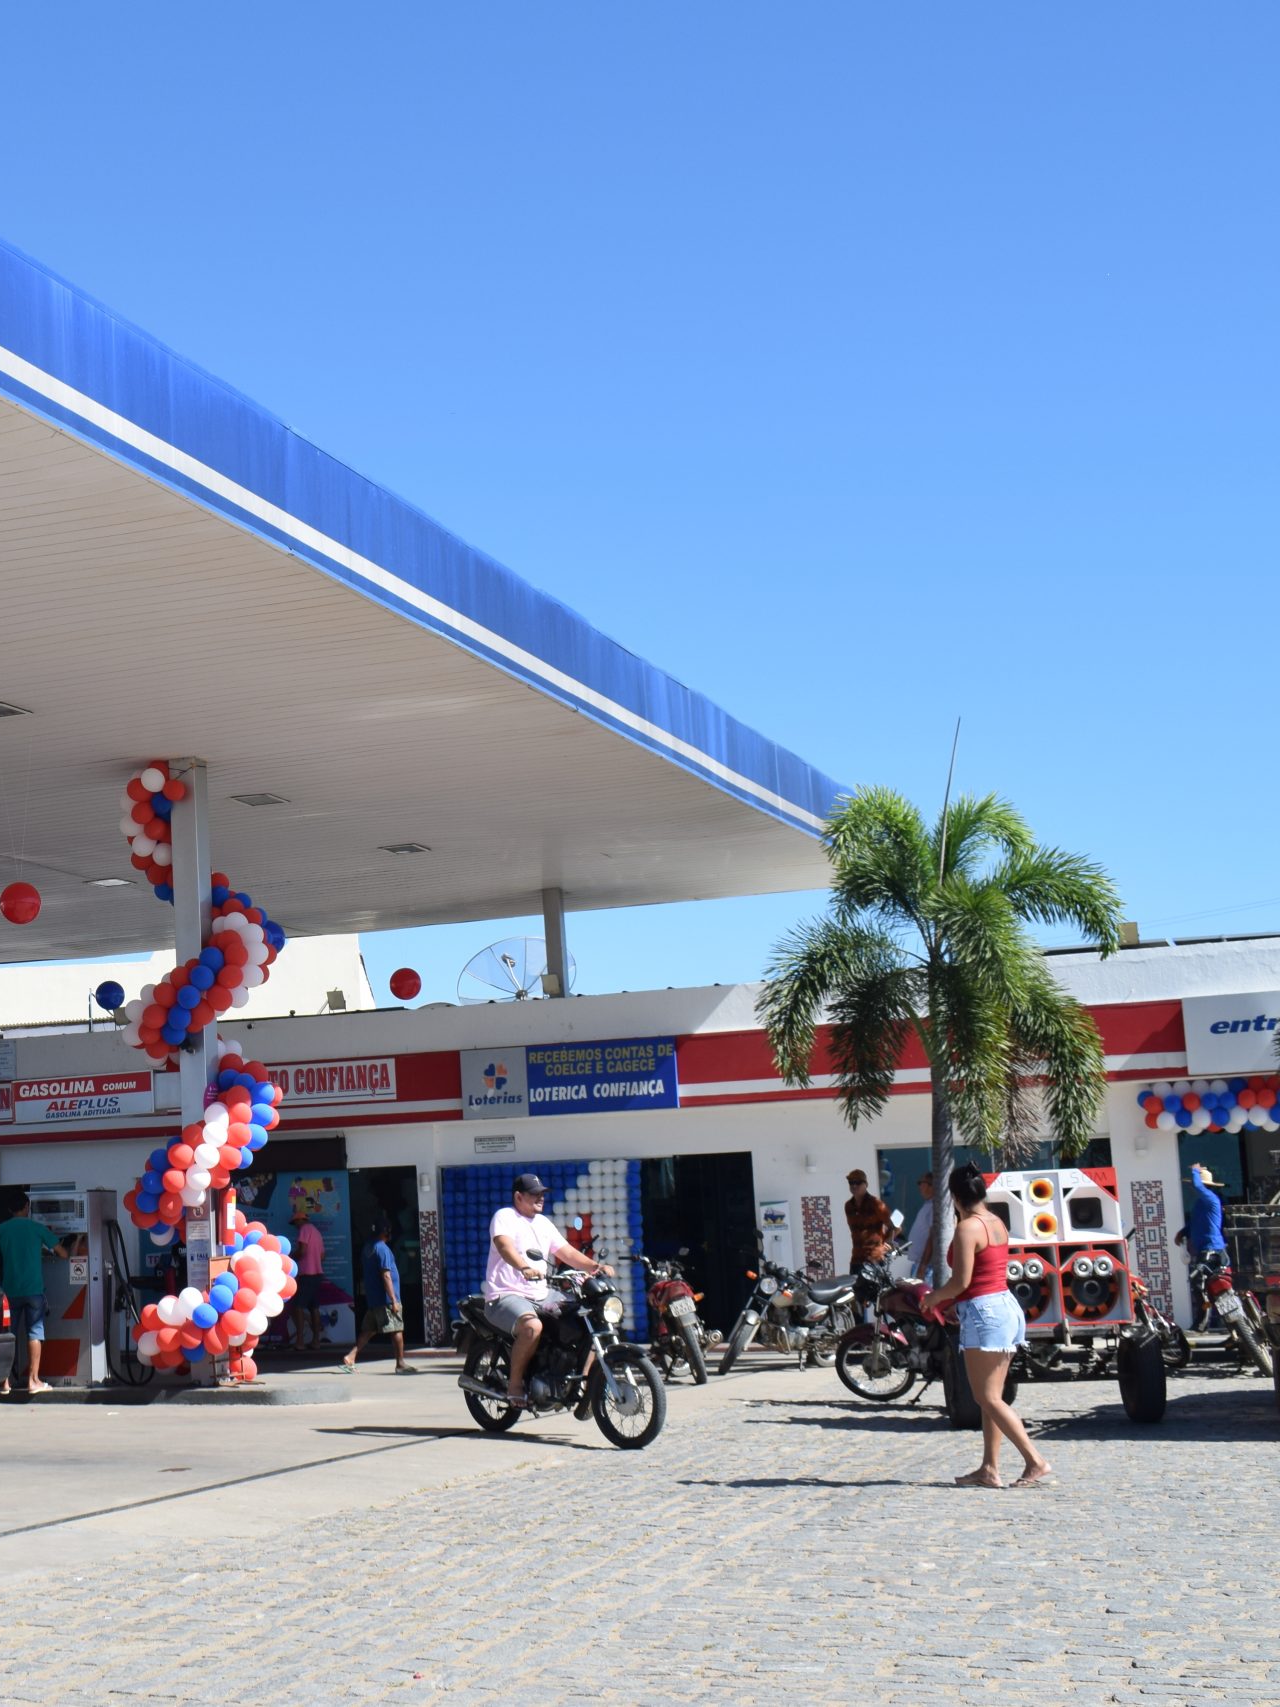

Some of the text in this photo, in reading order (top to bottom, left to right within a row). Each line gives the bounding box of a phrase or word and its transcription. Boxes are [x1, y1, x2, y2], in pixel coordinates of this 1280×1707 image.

[529, 1044, 674, 1064] RECEBEMOS CONTAS DE
[545, 1058, 656, 1077] COELCE E CAGECE
[19, 1079, 137, 1098] GASOLINA COMUM
[293, 1063, 391, 1097] CONFIANÇA
[468, 1091, 523, 1106] Loterias
[529, 1079, 665, 1103] LOTERICA CONFIANÇA
[45, 1107, 121, 1120] GASOLINA ADITIVADA
[46, 1096, 119, 1112] ALEPLUS
